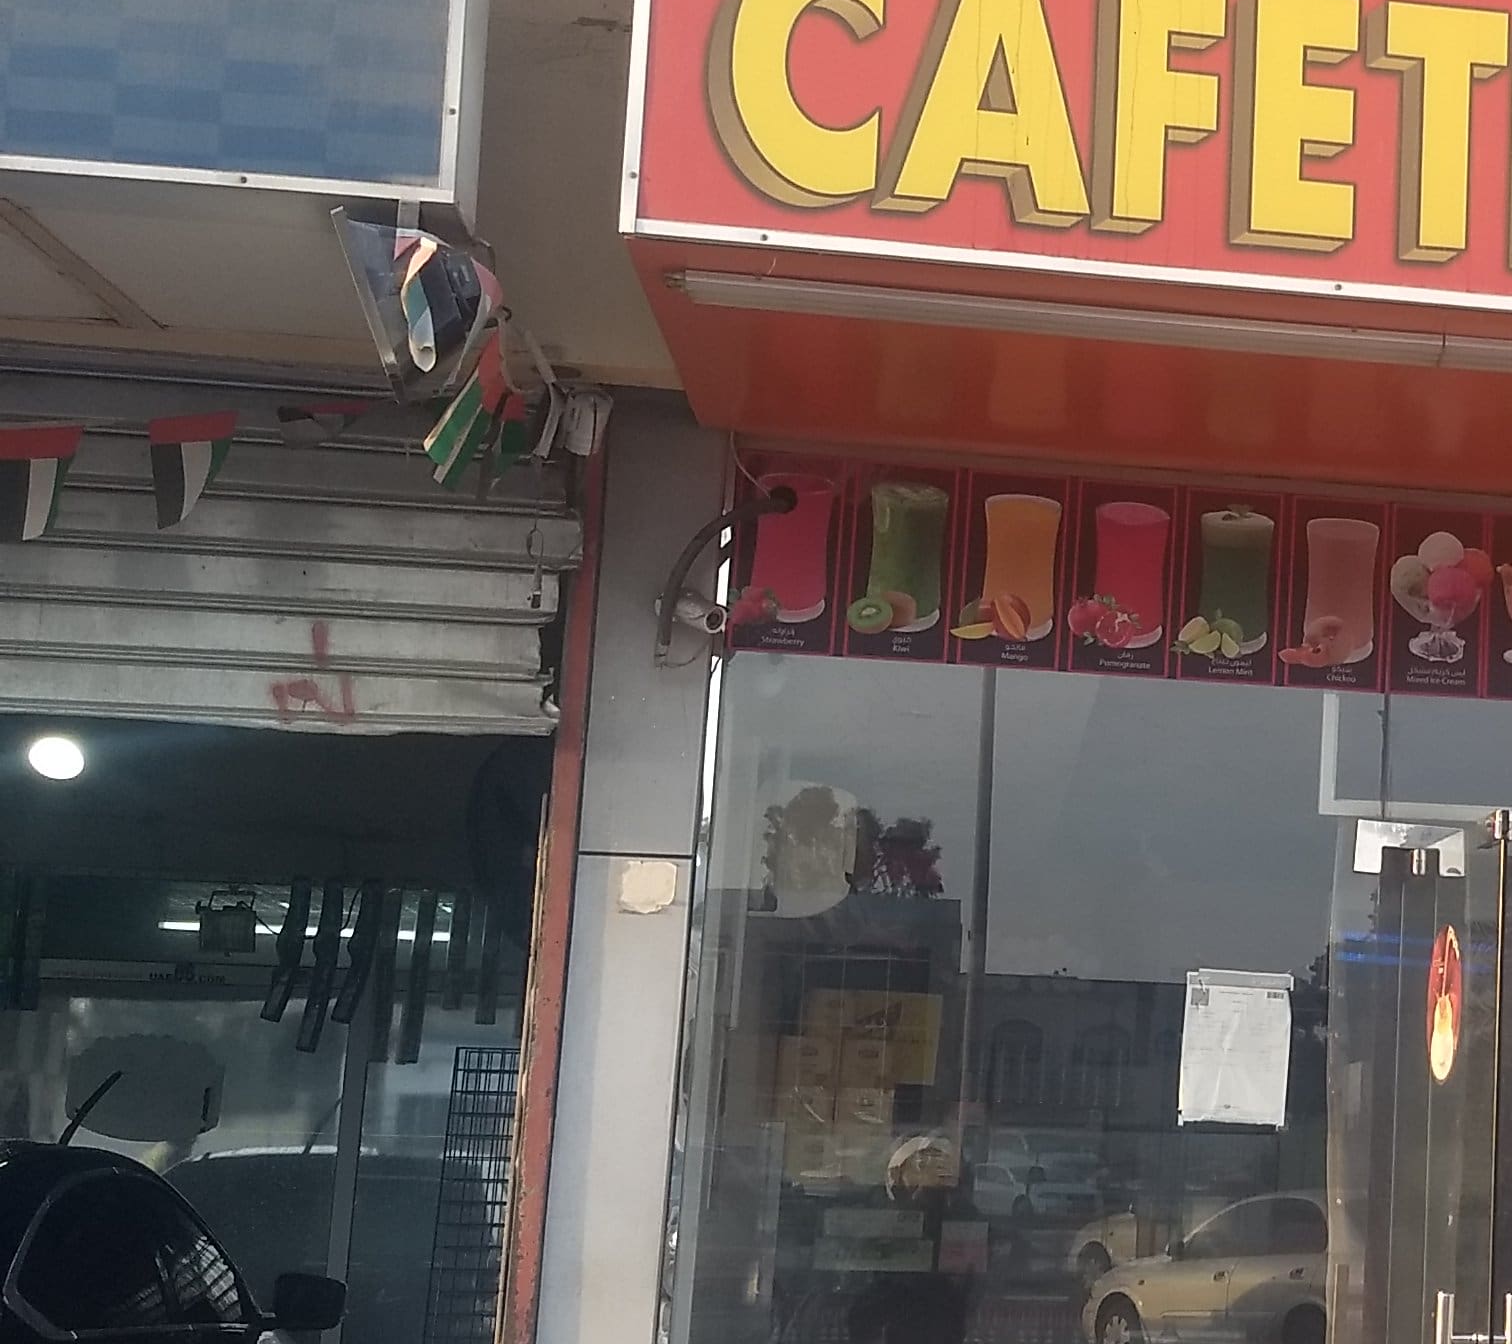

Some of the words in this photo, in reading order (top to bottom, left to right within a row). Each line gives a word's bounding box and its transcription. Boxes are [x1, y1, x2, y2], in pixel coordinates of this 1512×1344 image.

[761, 636, 805, 647] Strawberry
[1001, 652, 1029, 662] Mango
[1442, 677, 1466, 685] Cream
